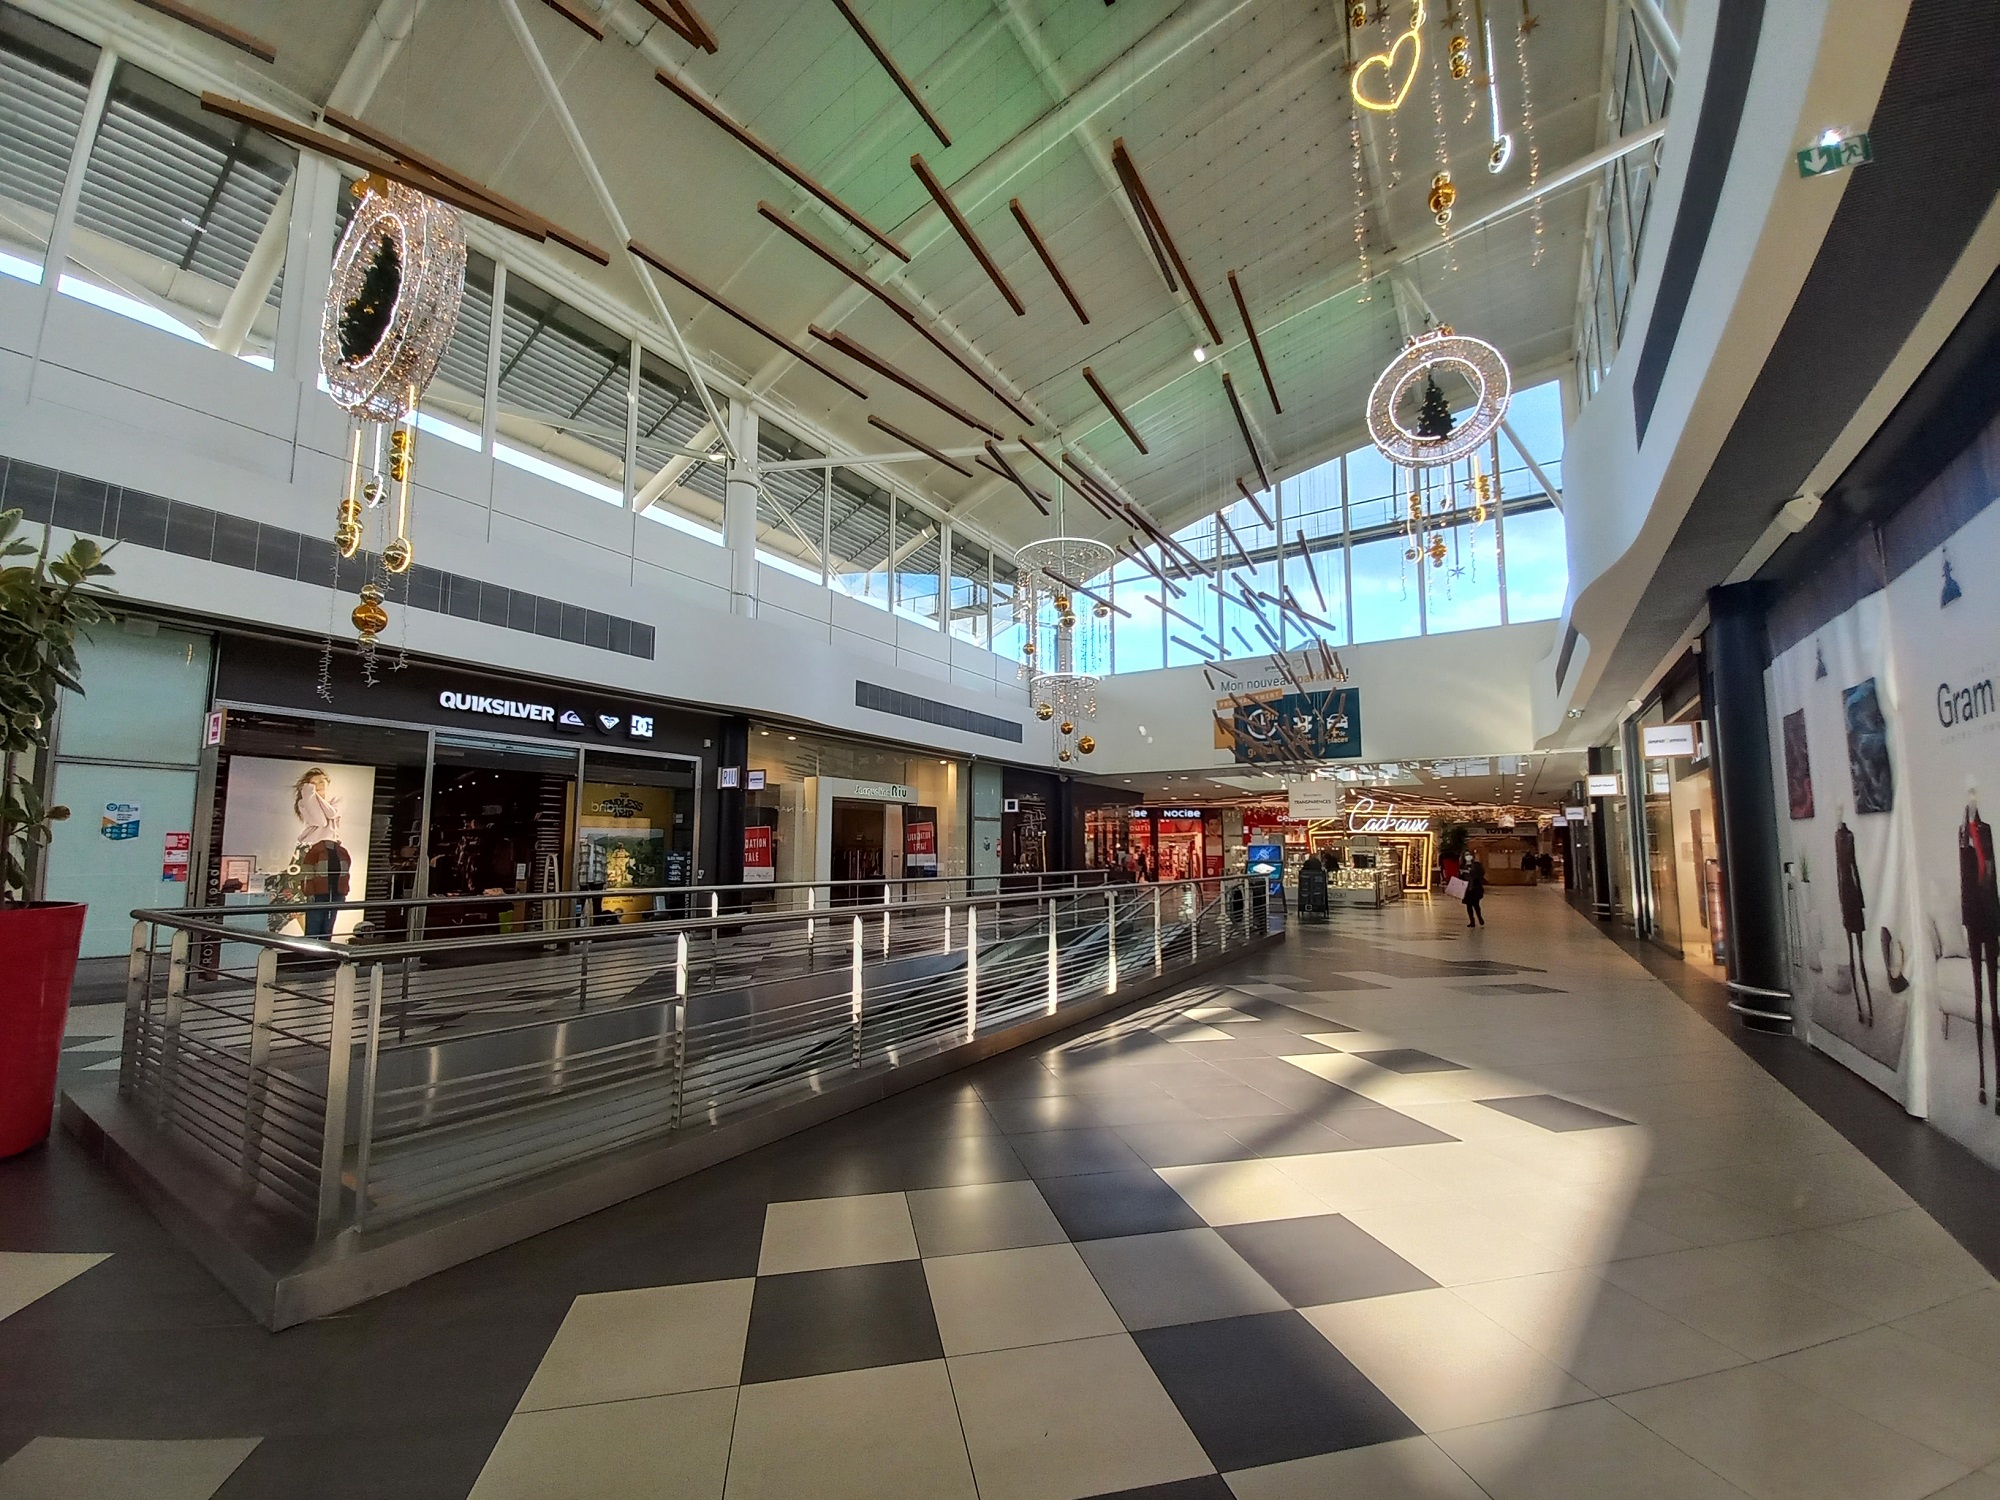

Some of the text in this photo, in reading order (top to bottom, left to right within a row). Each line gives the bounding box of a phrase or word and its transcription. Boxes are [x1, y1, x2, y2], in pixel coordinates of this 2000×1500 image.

[1220, 681, 1244, 692] Mon
[439, 691, 555, 722] QUIKSILVER
[723, 770, 737, 785] RIU
[890, 785, 908, 798] Riu
[1349, 798, 1430, 832] Cadeaux
